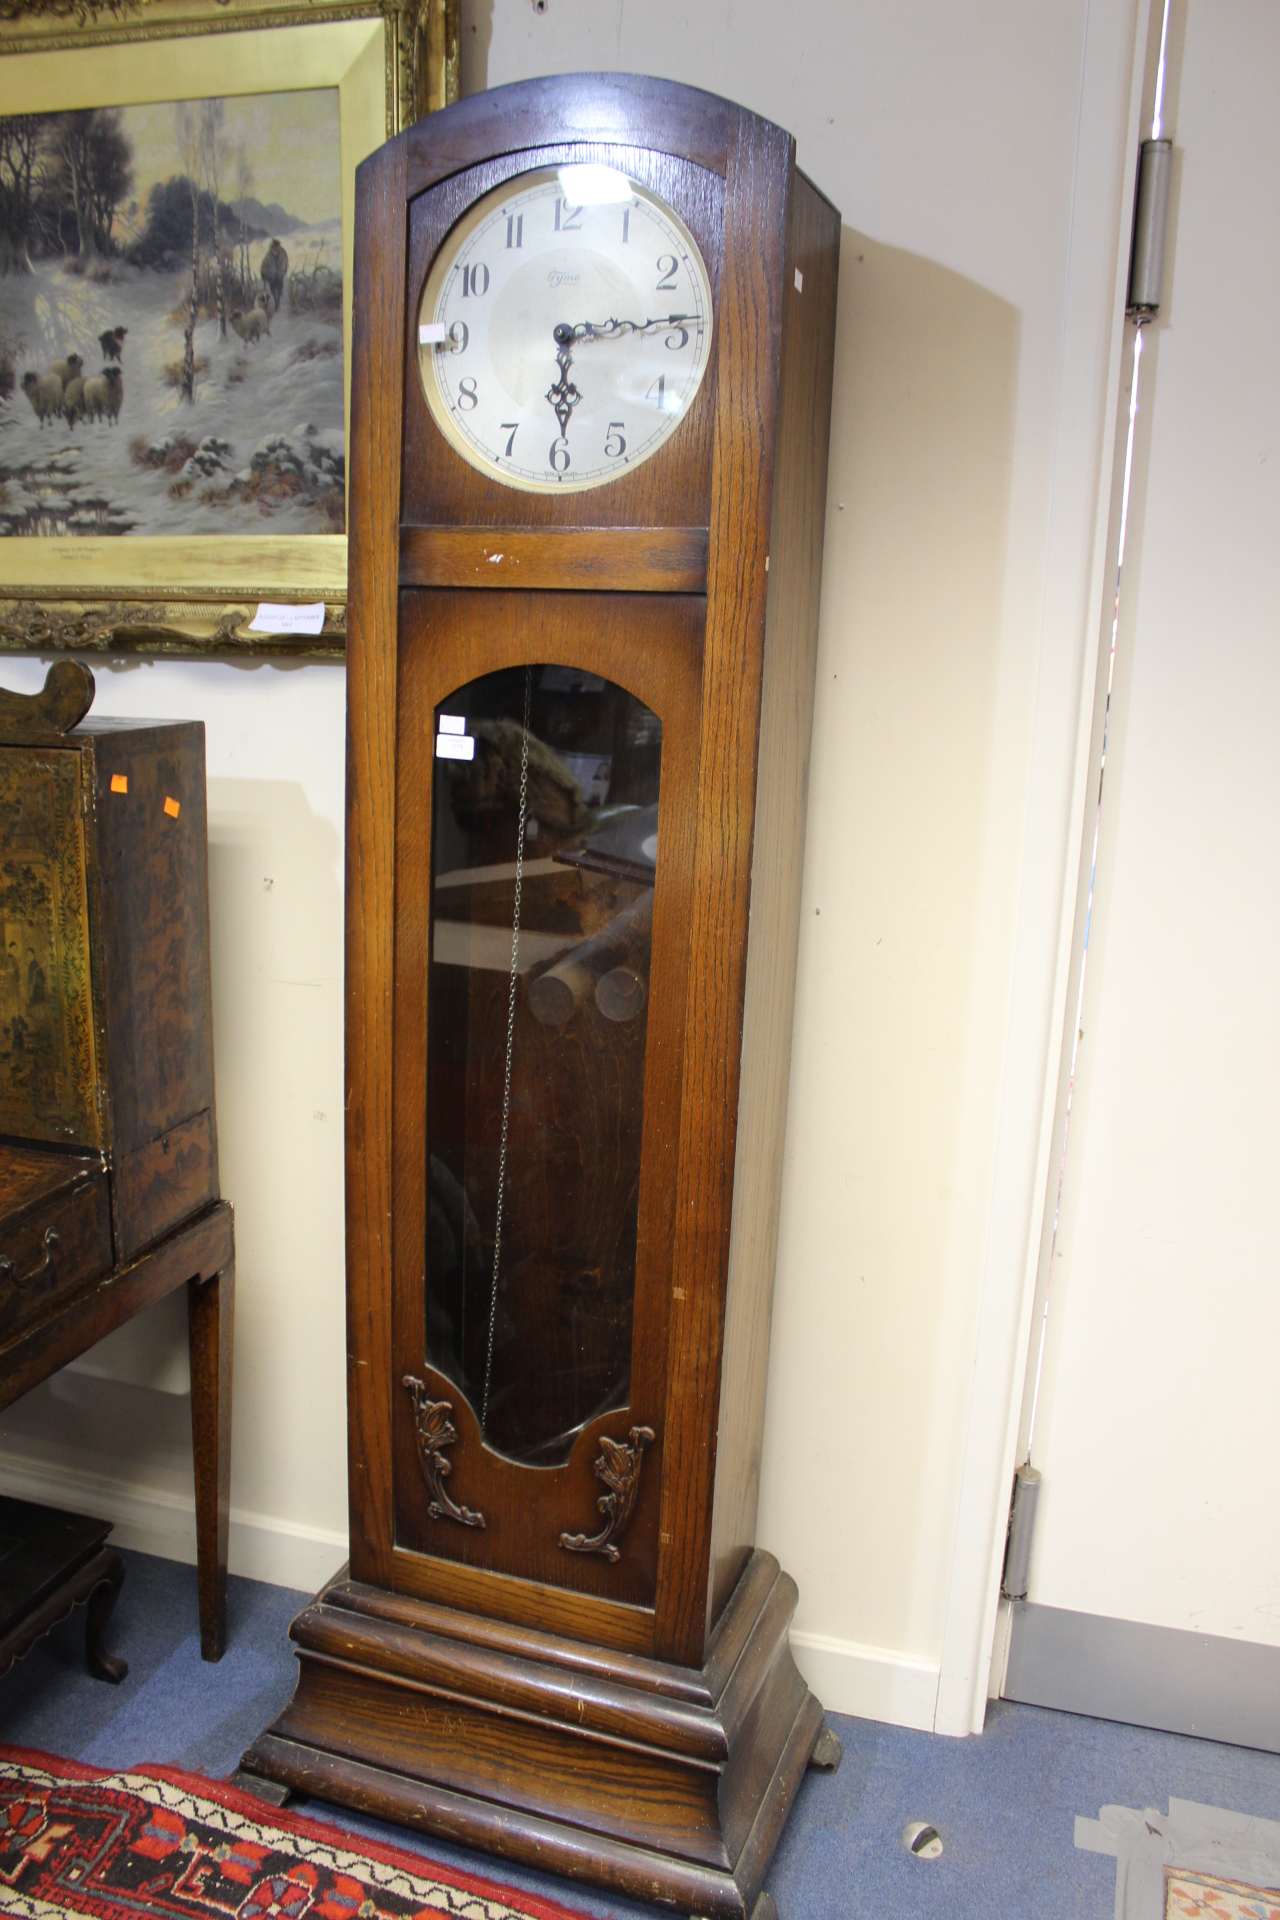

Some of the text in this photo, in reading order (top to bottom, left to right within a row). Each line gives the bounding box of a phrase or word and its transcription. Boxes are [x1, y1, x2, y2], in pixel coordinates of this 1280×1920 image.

[505, 212, 524, 249] 11
[553, 196, 582, 231] 12
[621, 208, 631, 243] 1
[460, 262, 490, 297] 10
[656, 254, 679, 290] 2
[448, 321, 470, 355] 9
[664, 315, 689, 350] 3
[457, 377, 478, 411] 8
[645, 373, 669, 409] 4
[500, 422, 519, 457] 7
[549, 437, 571, 472] 6
[604, 422, 627, 457] 5
